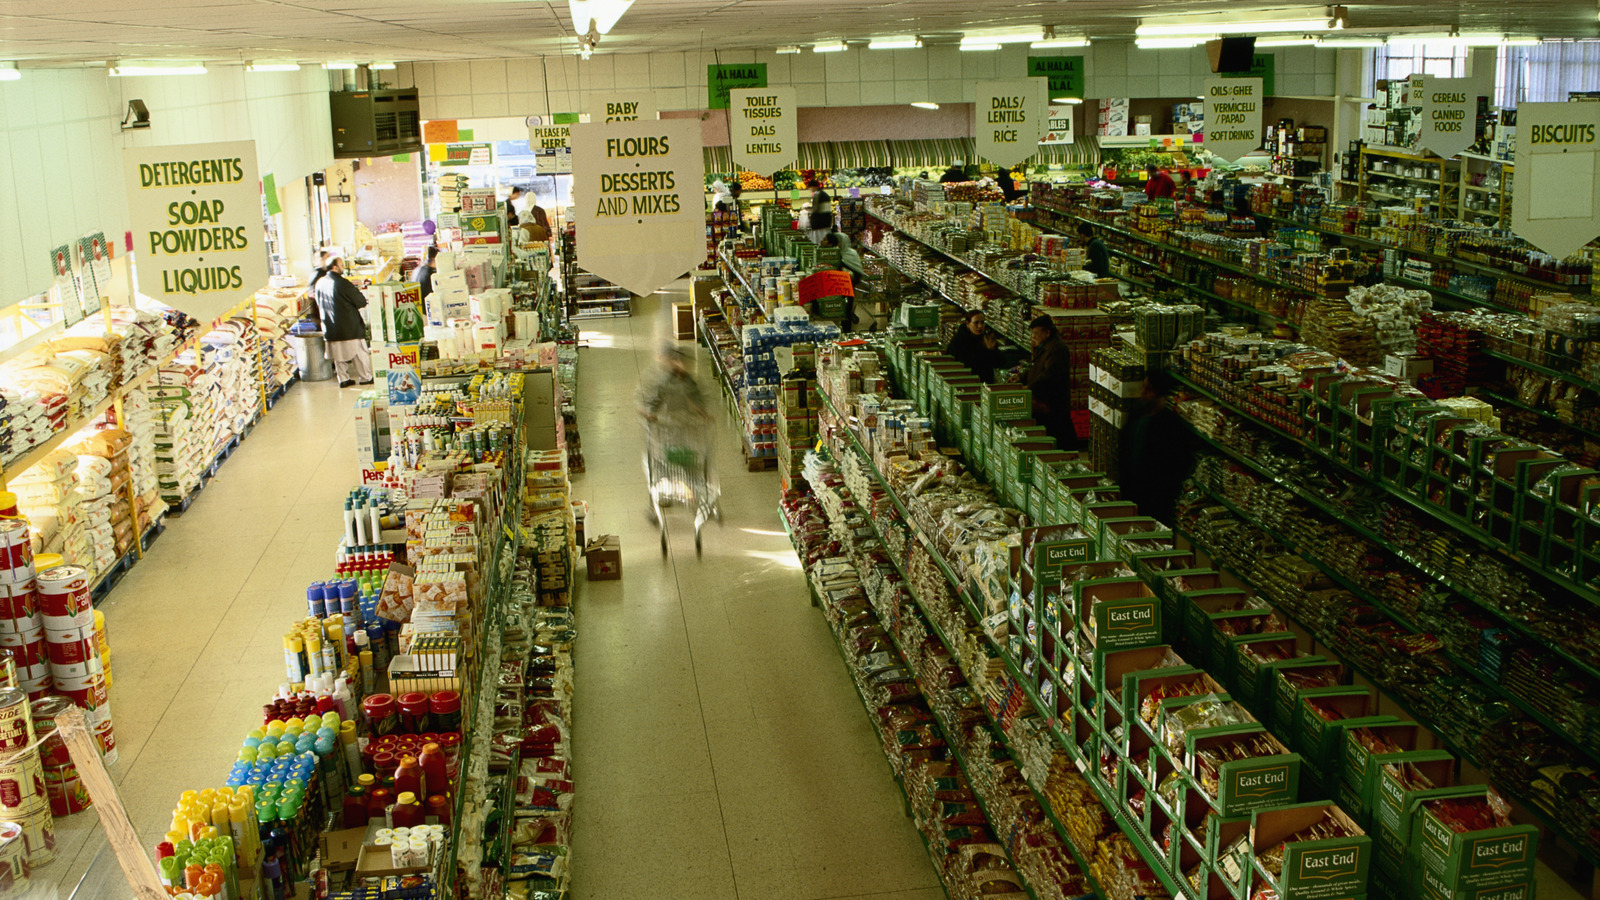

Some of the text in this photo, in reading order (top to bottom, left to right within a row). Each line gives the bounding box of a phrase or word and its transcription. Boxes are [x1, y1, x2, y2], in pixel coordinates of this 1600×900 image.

[1048, 61, 1074, 71] HALAL
[716, 69, 758, 80] AL HALAL
[1210, 86, 1228, 96] OILS
[1233, 85, 1252, 96] GHEE
[746, 96, 778, 107] TOILET
[1432, 93, 1466, 103] CEREALS
[606, 101, 639, 115] BABY
[743, 107, 782, 118] TISSUES
[1213, 102, 1255, 113] VERMICELLI
[988, 110, 1025, 123] LENTILS
[1432, 110, 1465, 120] CANNED
[535, 127, 560, 138] PLEASE
[751, 125, 775, 136] DALS
[1434, 122, 1462, 132] FOODS
[1531, 124, 1596, 143] BISCUITS
[993, 130, 1018, 142] RICE
[1210, 130, 1254, 141] SOFT DRINKS
[541, 138, 566, 148] HERE
[606, 136, 669, 158] FLOURS
[746, 143, 782, 154] LENTILS
[139, 158, 244, 188] DETERGENTS
[601, 171, 675, 193] DESSERTS
[596, 193, 681, 217] AND MIXES
[168, 199, 225, 226] SOAP
[149, 226, 248, 255] POWDERS
[163, 265, 243, 294] LIQUIDS
[395, 289, 420, 308] Persil
[388, 351, 417, 369] Persil
[362, 468, 387, 485] Pers
[1050, 547, 1085, 559] East End
[1110, 608, 1150, 621] East End
[1240, 771, 1285, 787] East End
[1383, 776, 1402, 802] East End
[1424, 818, 1449, 846] East End
[1477, 840, 1524, 857] East End
[1305, 851, 1355, 869] East End
[1426, 869, 1452, 900] East End
